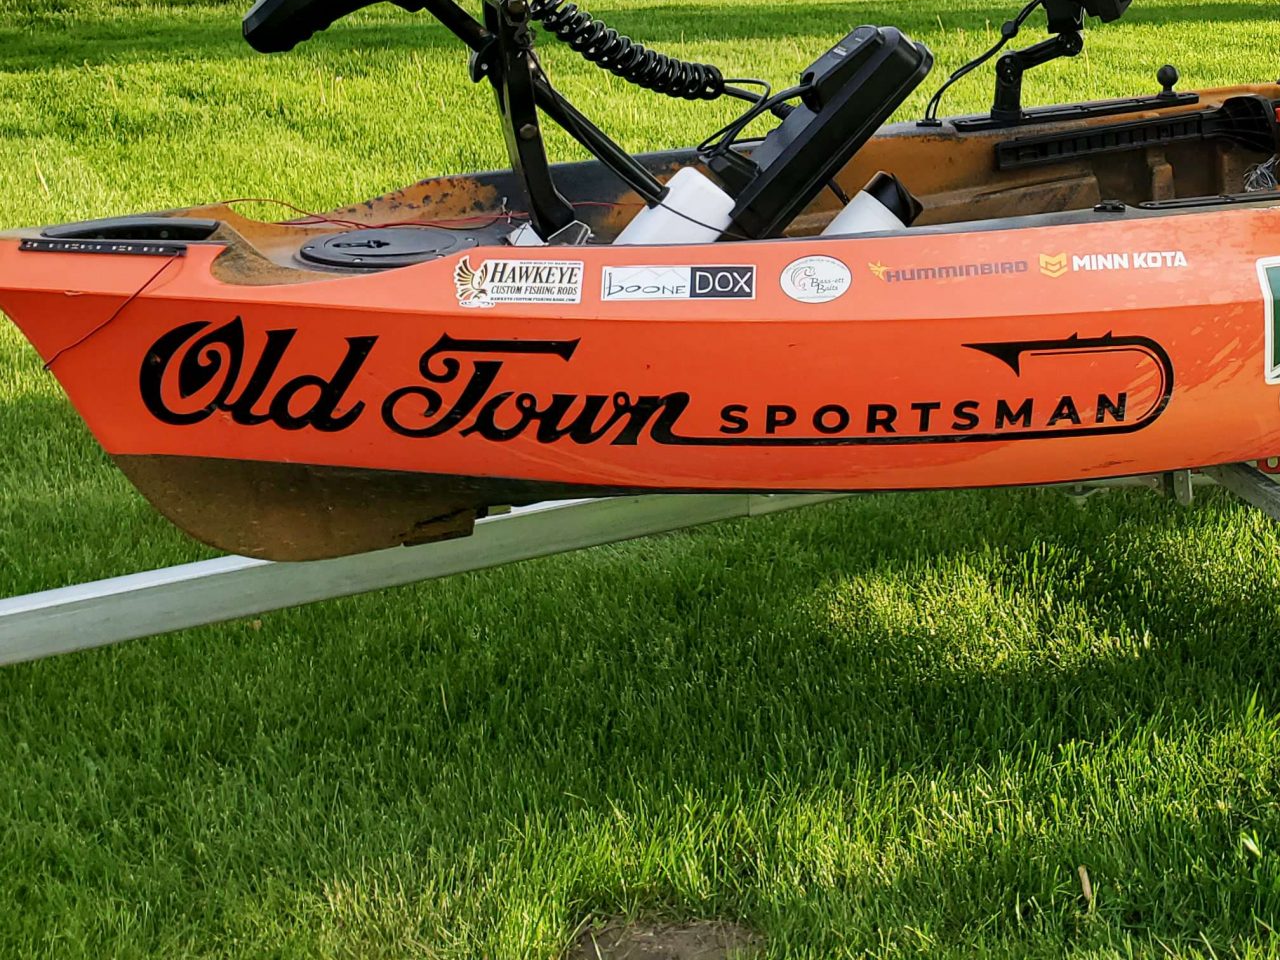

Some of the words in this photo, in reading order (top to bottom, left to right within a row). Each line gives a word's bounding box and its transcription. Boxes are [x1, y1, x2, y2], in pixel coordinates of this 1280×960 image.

[886, 259, 1028, 283] HUMMINBIRD
[1072, 252, 1129, 272] MINN
[1132, 250, 1188, 270] KOTA
[489, 262, 581, 285] HAWKEYE
[695, 270, 752, 294] DOX
[490, 285, 522, 295] CUSTOM
[524, 286, 555, 296] FISHING
[557, 286, 578, 296] RODS
[139, 315, 380, 433] Old
[380, 331, 692, 447] Town
[719, 392, 1128, 434] SPORTSMAN
